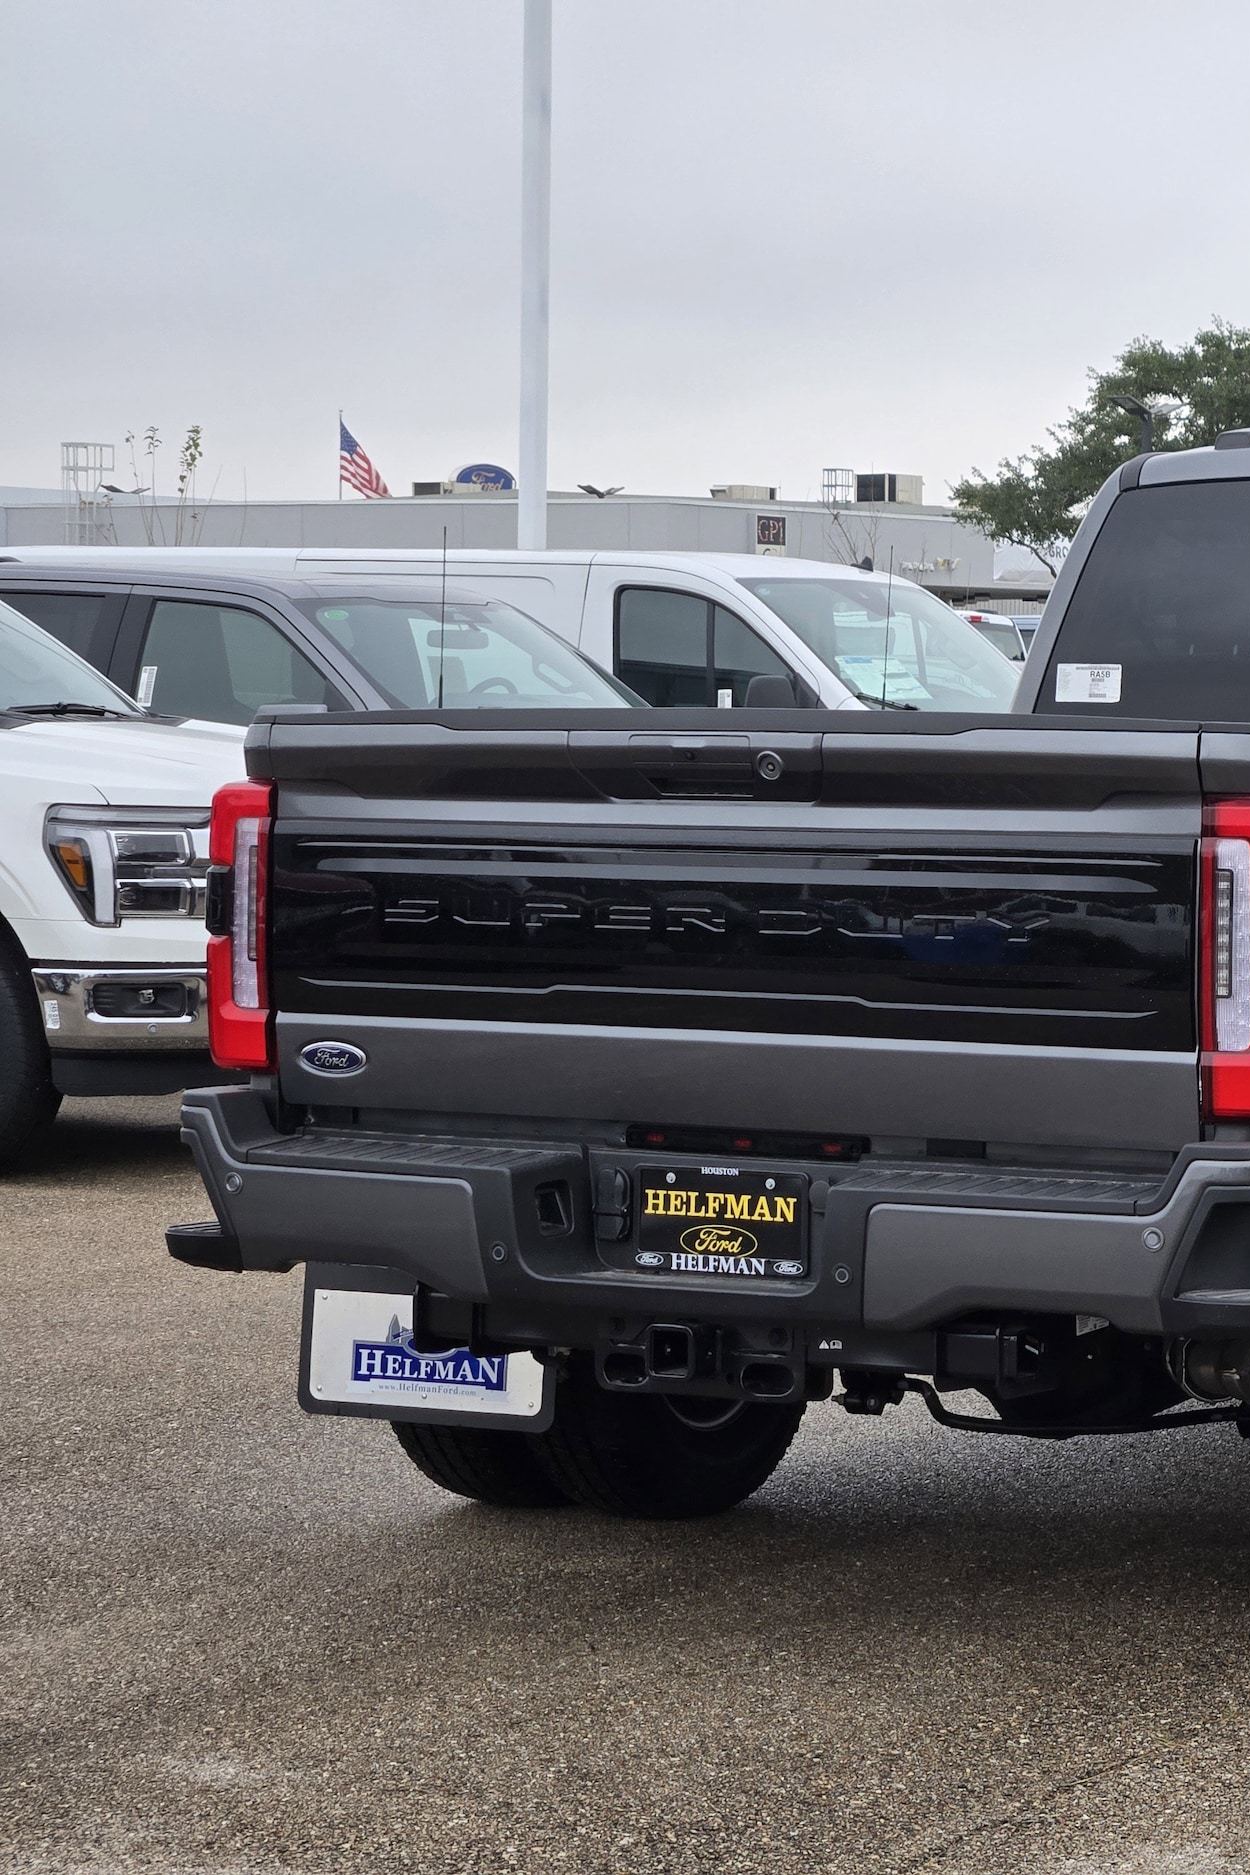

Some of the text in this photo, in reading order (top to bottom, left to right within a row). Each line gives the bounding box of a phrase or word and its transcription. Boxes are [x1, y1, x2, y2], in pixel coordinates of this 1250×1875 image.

[384, 898, 1050, 943] SUPER DUTY
[314, 1047, 350, 1068] Ford
[701, 1166, 739, 1177] HOUSTON
[644, 1189, 797, 1223] HELFMAN
[695, 1227, 743, 1254] Ford
[670, 1252, 766, 1276] HELFMAN
[357, 1348, 502, 1384] HELFMAN
[378, 1382, 477, 1397] www.HelfmanFord.com
